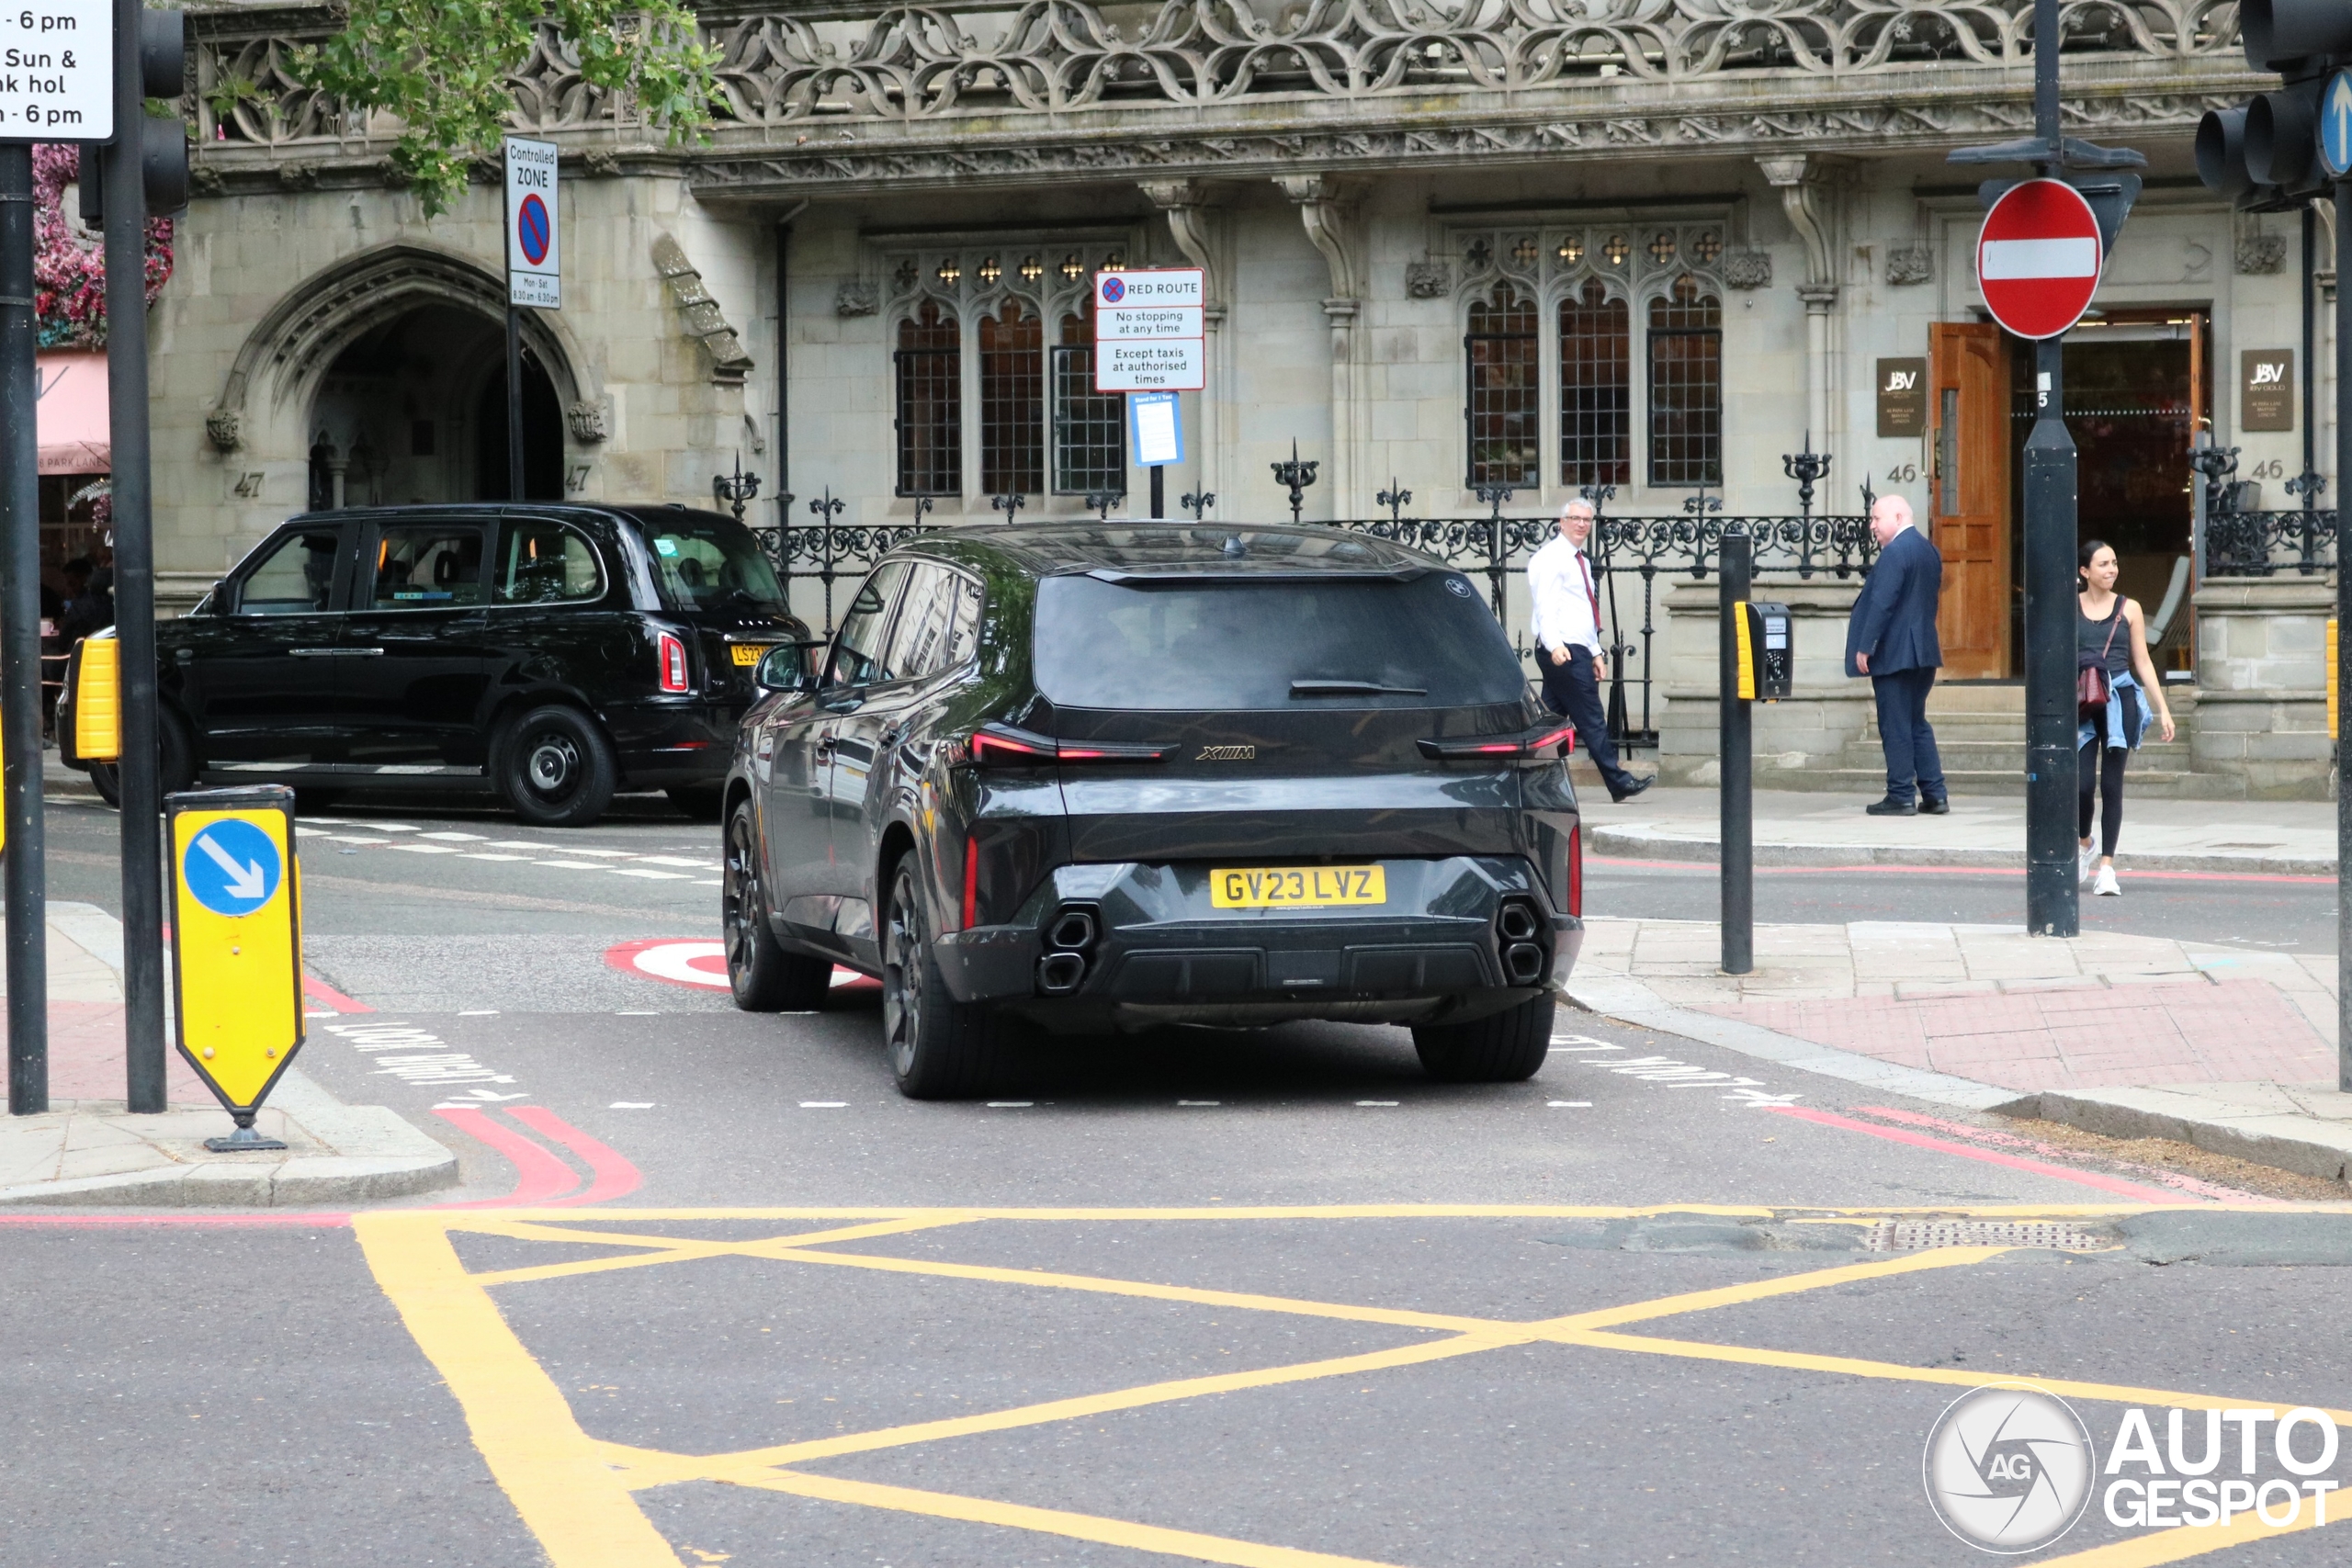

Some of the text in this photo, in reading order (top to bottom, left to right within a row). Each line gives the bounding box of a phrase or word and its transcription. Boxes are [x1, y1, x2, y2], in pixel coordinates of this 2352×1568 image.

[20, 10, 34, 29] 6
[41, 16, 76, 33] pm
[5, 48, 76, 68] Sun &
[29, 74, 65, 94] hol
[26, 104, 40, 123] 6
[47, 109, 82, 127] pm
[510, 144, 554, 164] Controlled
[517, 167, 548, 188] ZONE
[524, 277, 535, 288] Mon
[538, 278, 548, 289] Sat
[1128, 283, 1197, 295] RED ROUTE
[1116, 311, 1182, 322] No stopping
[1119, 323, 1181, 335] at any time
[1115, 348, 1183, 359] Except taxis
[1113, 361, 1187, 371] at authorised
[1135, 375, 1165, 384] times
[2039, 391, 2048, 408] 5
[48, 458, 74, 468] PARK
[76, 457, 102, 467] LANE
[2252, 459, 2283, 479] 46
[565, 465, 591, 491] 47
[1887, 464, 1916, 483] 46
[234, 471, 265, 497] 47
[735, 647, 762, 661] LS23
[1226, 871, 1373, 901] GV23 LVZ
[323, 1021, 517, 1085] LOOK RIGHT
[1579, 1056, 1766, 1088] LOOK
